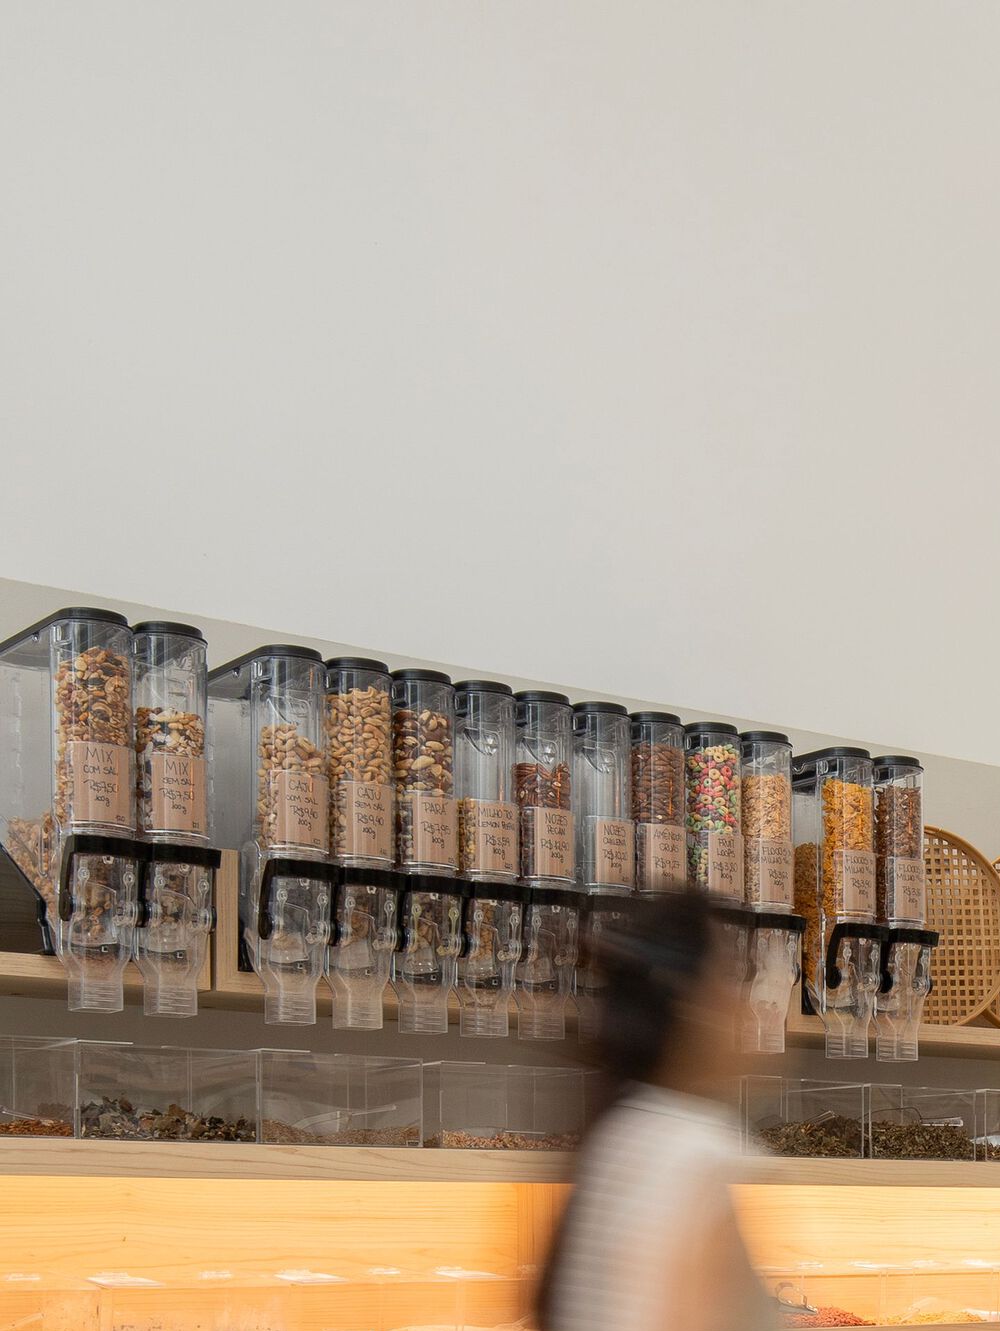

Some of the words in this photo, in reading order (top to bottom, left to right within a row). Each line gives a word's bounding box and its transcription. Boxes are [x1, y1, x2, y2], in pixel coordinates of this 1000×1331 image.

[85, 746, 114, 764] MIX
[83, 764, 101, 774] COM
[165, 760, 189, 776] MIX
[288, 780, 314, 793] CAJU
[357, 786, 382, 800] CAJU
